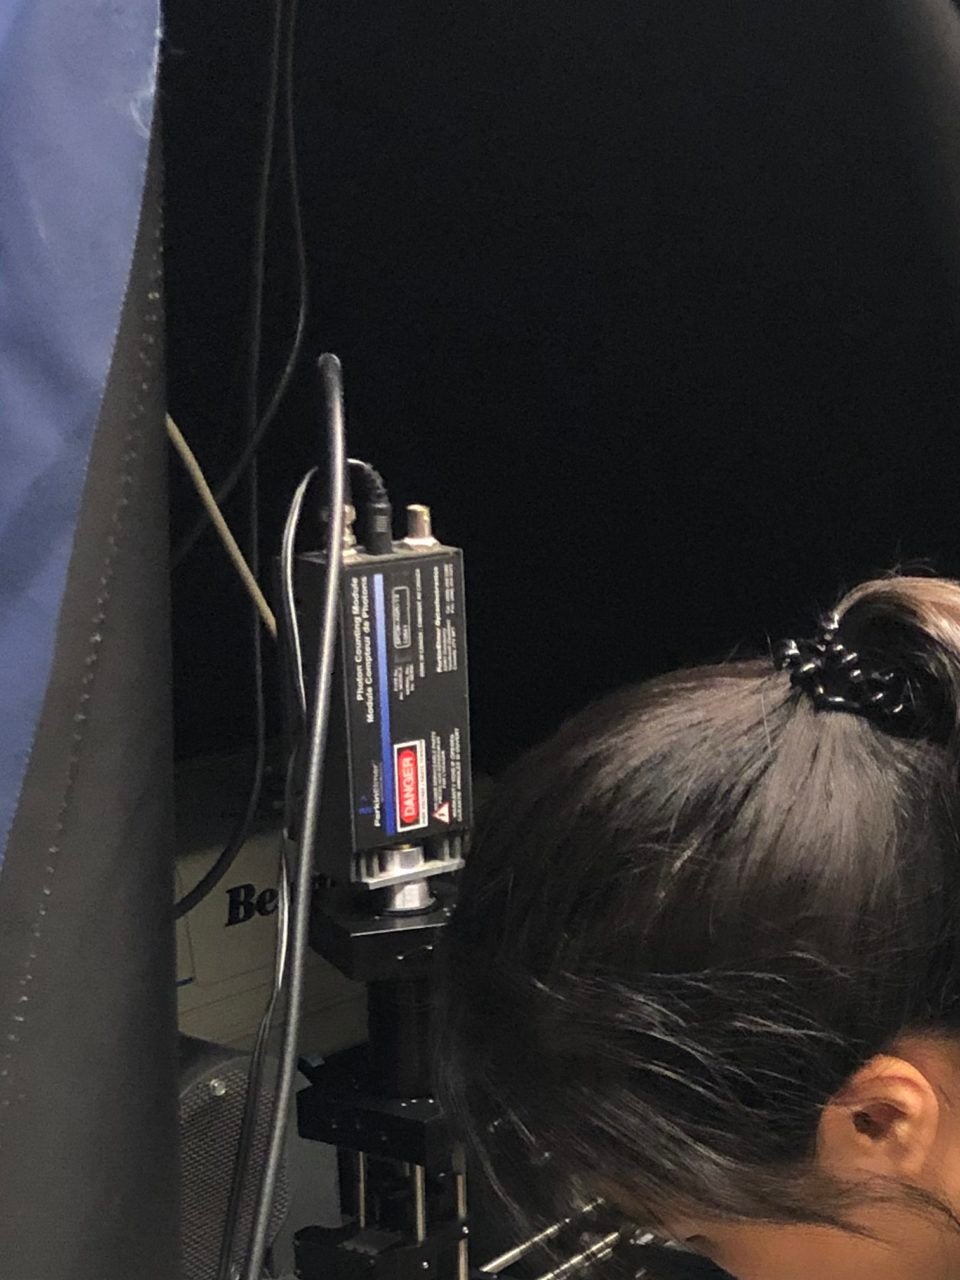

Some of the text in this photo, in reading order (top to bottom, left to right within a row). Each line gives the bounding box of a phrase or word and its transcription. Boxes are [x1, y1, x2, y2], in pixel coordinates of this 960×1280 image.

[352, 577, 364, 701] Photon Counting Module
[361, 576, 374, 723] Module Compteur de Photons
[403, 757, 415, 817] DANGER
